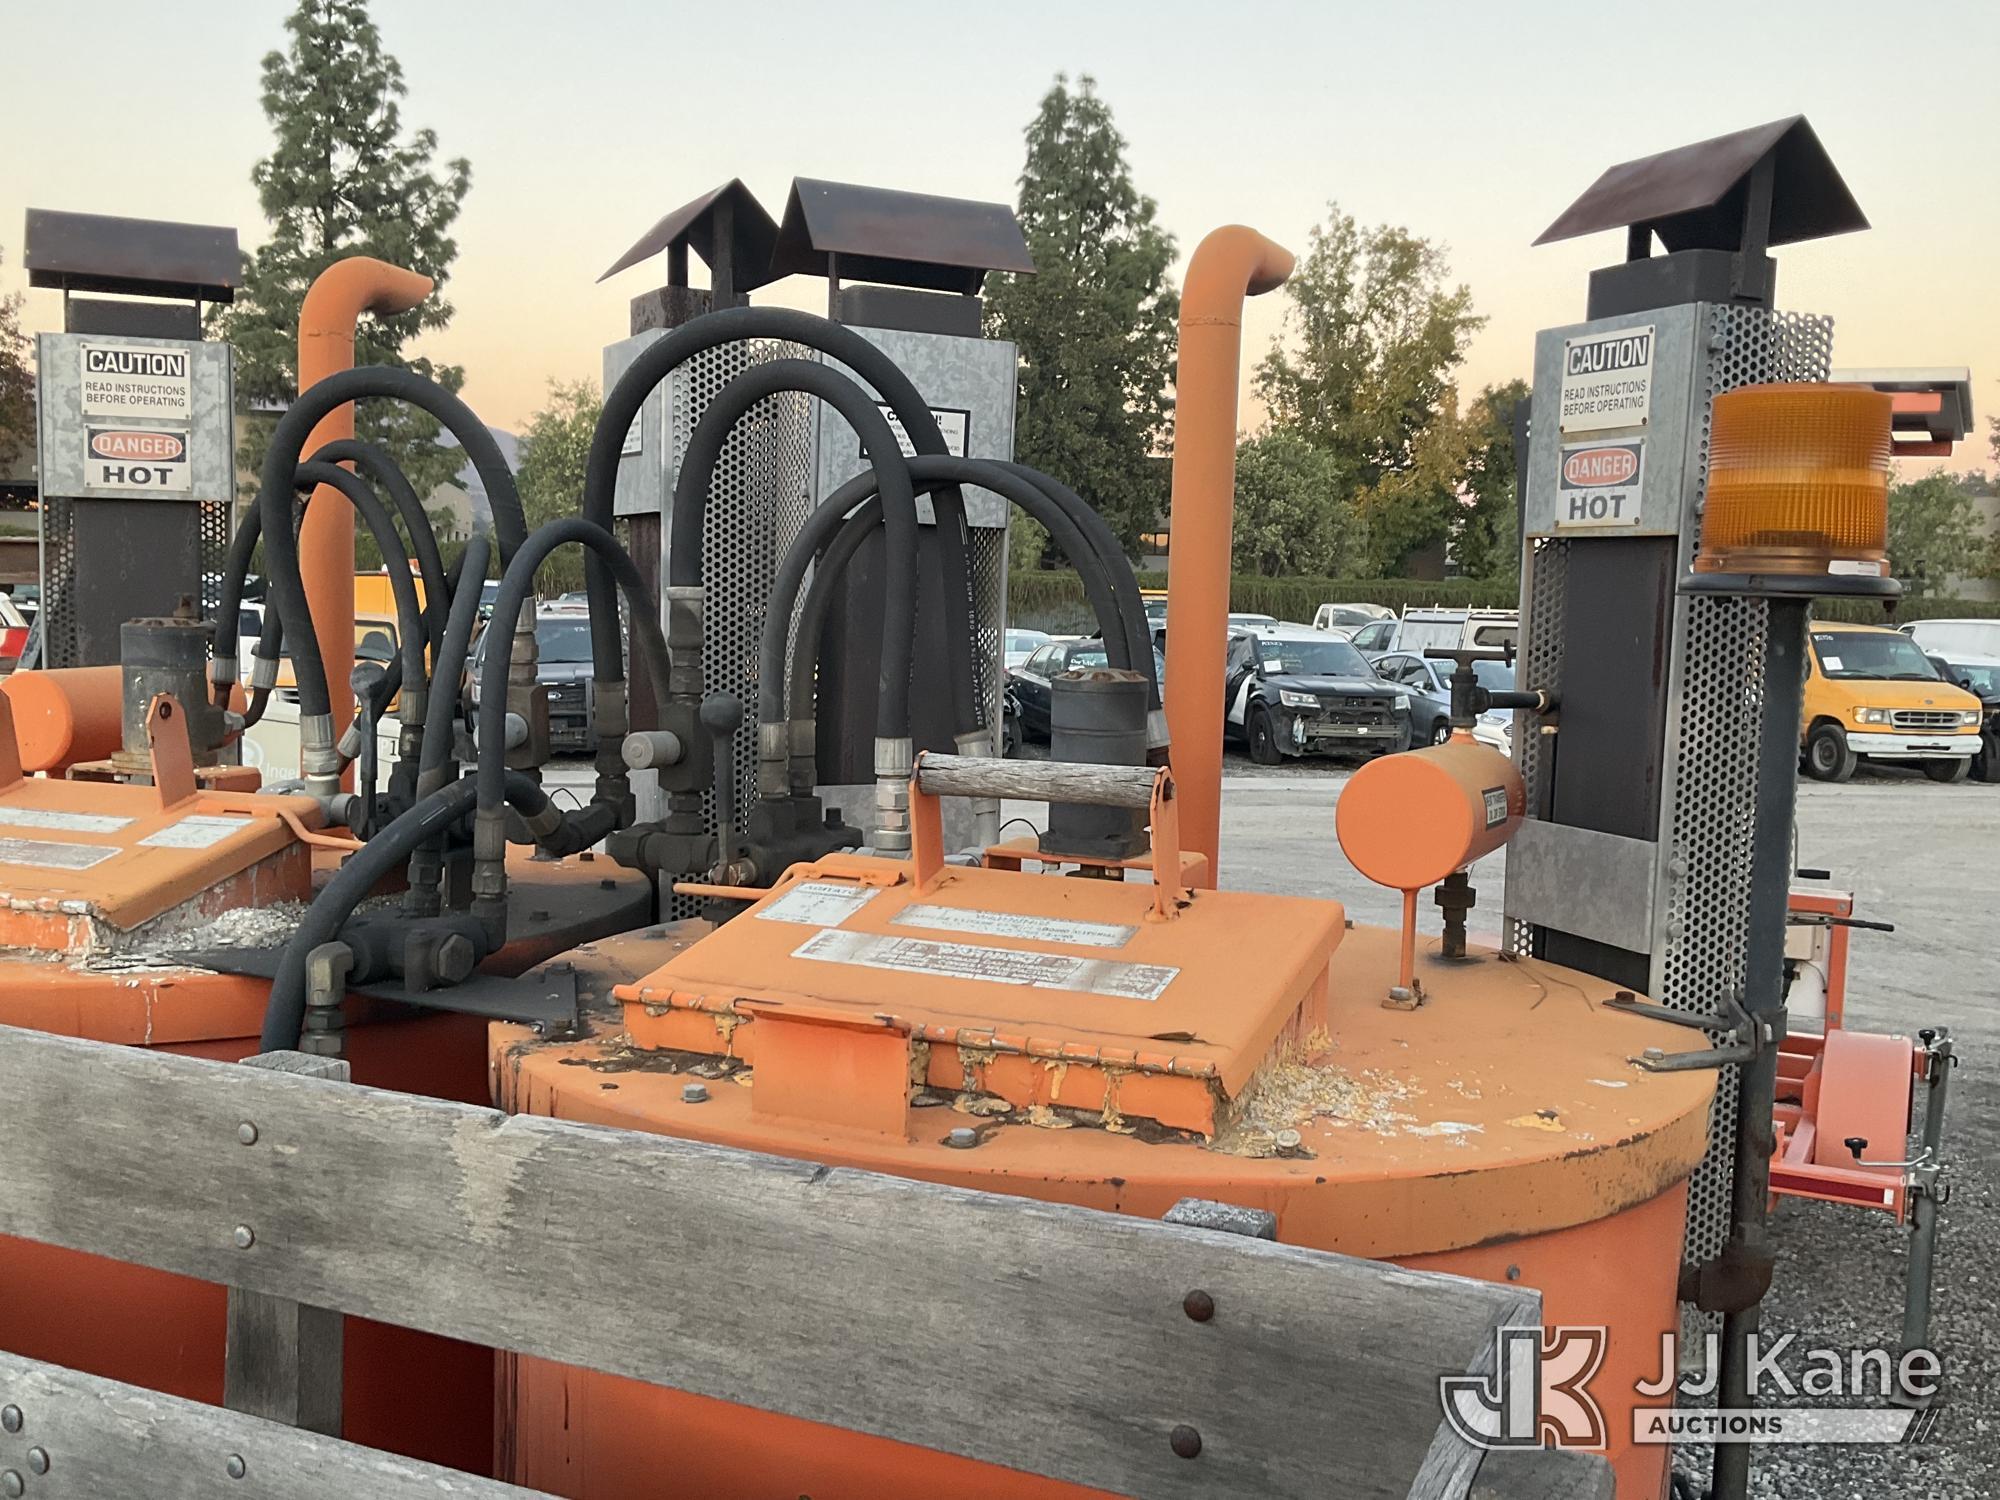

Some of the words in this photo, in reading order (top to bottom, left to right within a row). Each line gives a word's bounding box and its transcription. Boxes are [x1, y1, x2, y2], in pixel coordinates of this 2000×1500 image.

[89, 351, 182, 376] CAUTION
[1569, 336, 1648, 375] CAUTION
[85, 382, 112, 392] READ
[115, 383, 185, 396] INSTRUCTIONS
[1564, 386, 1586, 401] READ
[1587, 379, 1646, 398] INSTRUCTIONS
[87, 393, 126, 404] BEFORE
[129, 395, 185, 407] OPERATING
[1564, 400, 1595, 416] BEFORE
[1597, 395, 1644, 413] OPERATING
[99, 436, 176, 454] DANGER
[103, 465, 173, 485] HOT
[1569, 453, 1633, 479] DANGER
[1569, 494, 1627, 520] HOT
